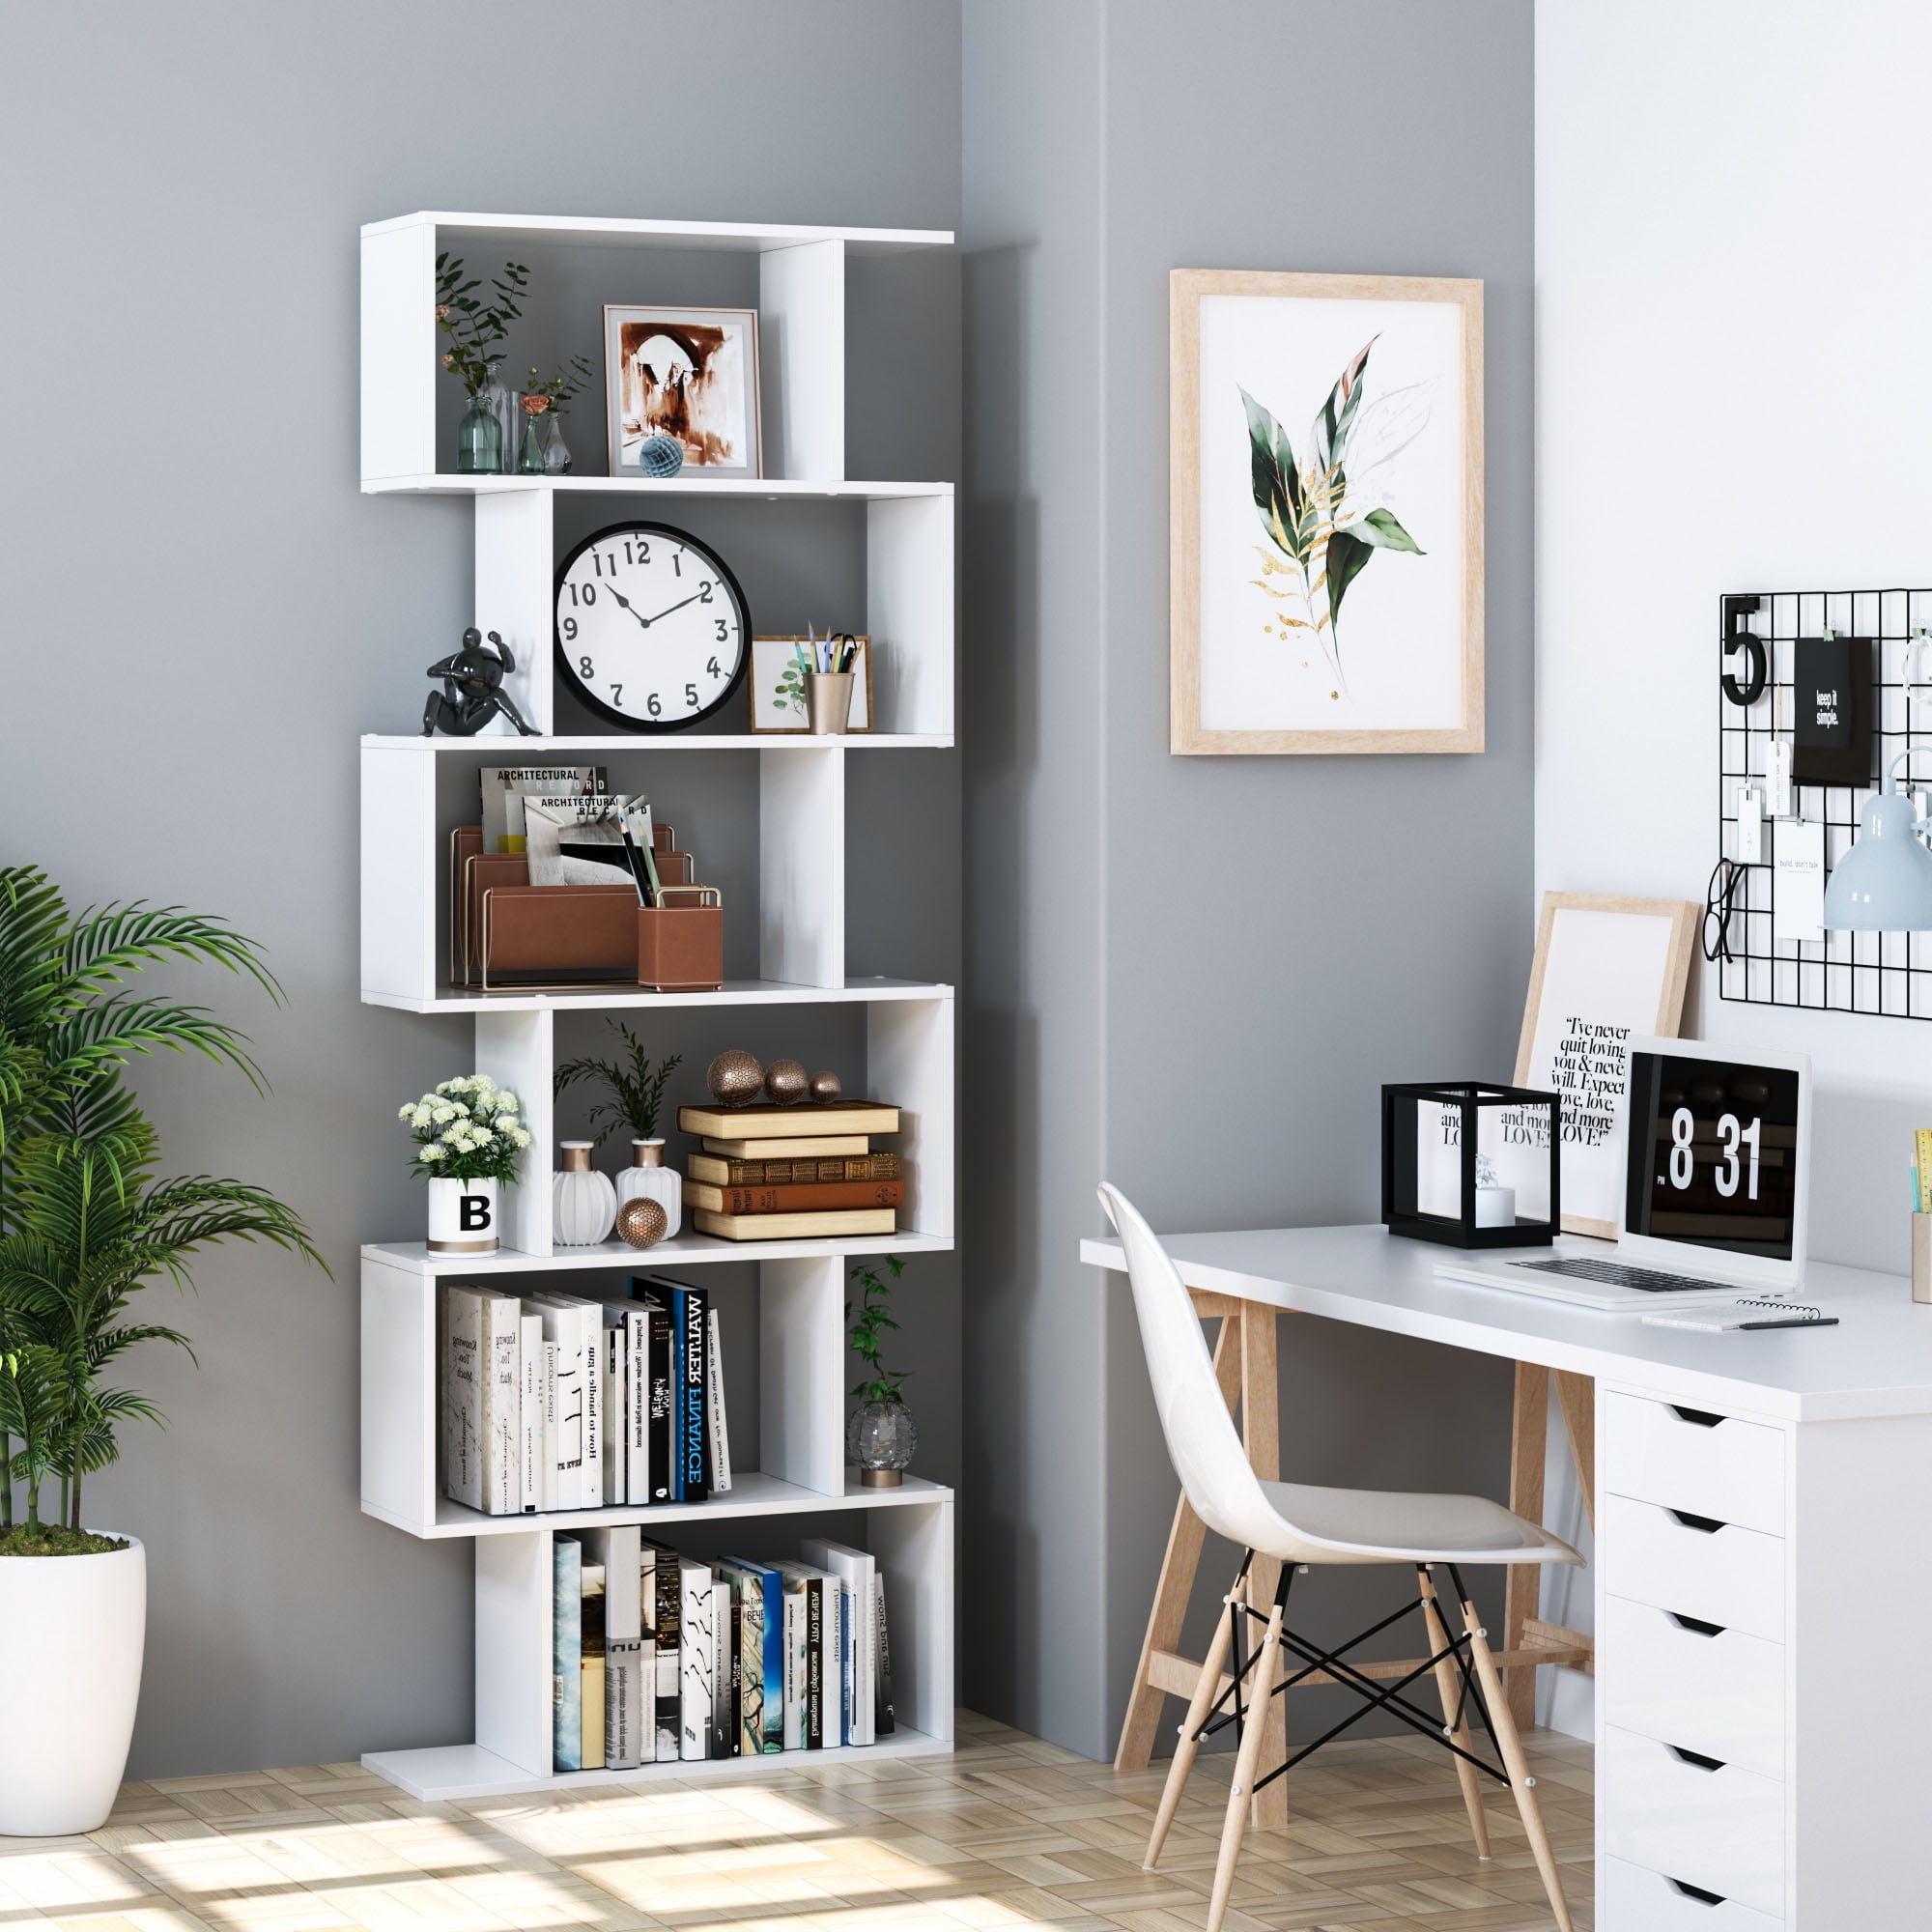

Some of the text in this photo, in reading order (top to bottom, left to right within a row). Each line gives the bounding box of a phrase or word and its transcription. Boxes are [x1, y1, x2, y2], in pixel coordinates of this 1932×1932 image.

[624, 541, 651, 565] 12
[593, 554, 617, 577] 11
[672, 554, 681, 577] 1
[569, 582, 597, 607] 10
[698, 581, 714, 603] 2
[563, 617, 578, 640] 9
[714, 619, 728, 641] 3
[1721, 596, 1767, 706] 5
[580, 656, 595, 679] 8
[706, 656, 721, 678] 4
[610, 684, 623, 706] 7
[647, 693, 662, 716] 6
[685, 683, 698, 706] 5
[1816, 689, 1837, 710] keep it
[1816, 708, 1838, 729] simple.
[497, 770, 580, 781] ARCHITECTURAL
[579, 807, 647, 815] RECRD
[1594, 1025, 1631, 1040] never
[1560, 1037, 1626, 1063] quit loving
[1552, 1054, 1625, 1076] you & neve
[1551, 1070, 1625, 1097] will. Expect
[1586, 1092, 1614, 1113] love,
[1560, 1108, 1613, 1130] nd more
[1669, 1107, 1761, 1201] 8 31
[1657, 1176, 1665, 1186] PM
[460, 1195, 492, 1232] B
